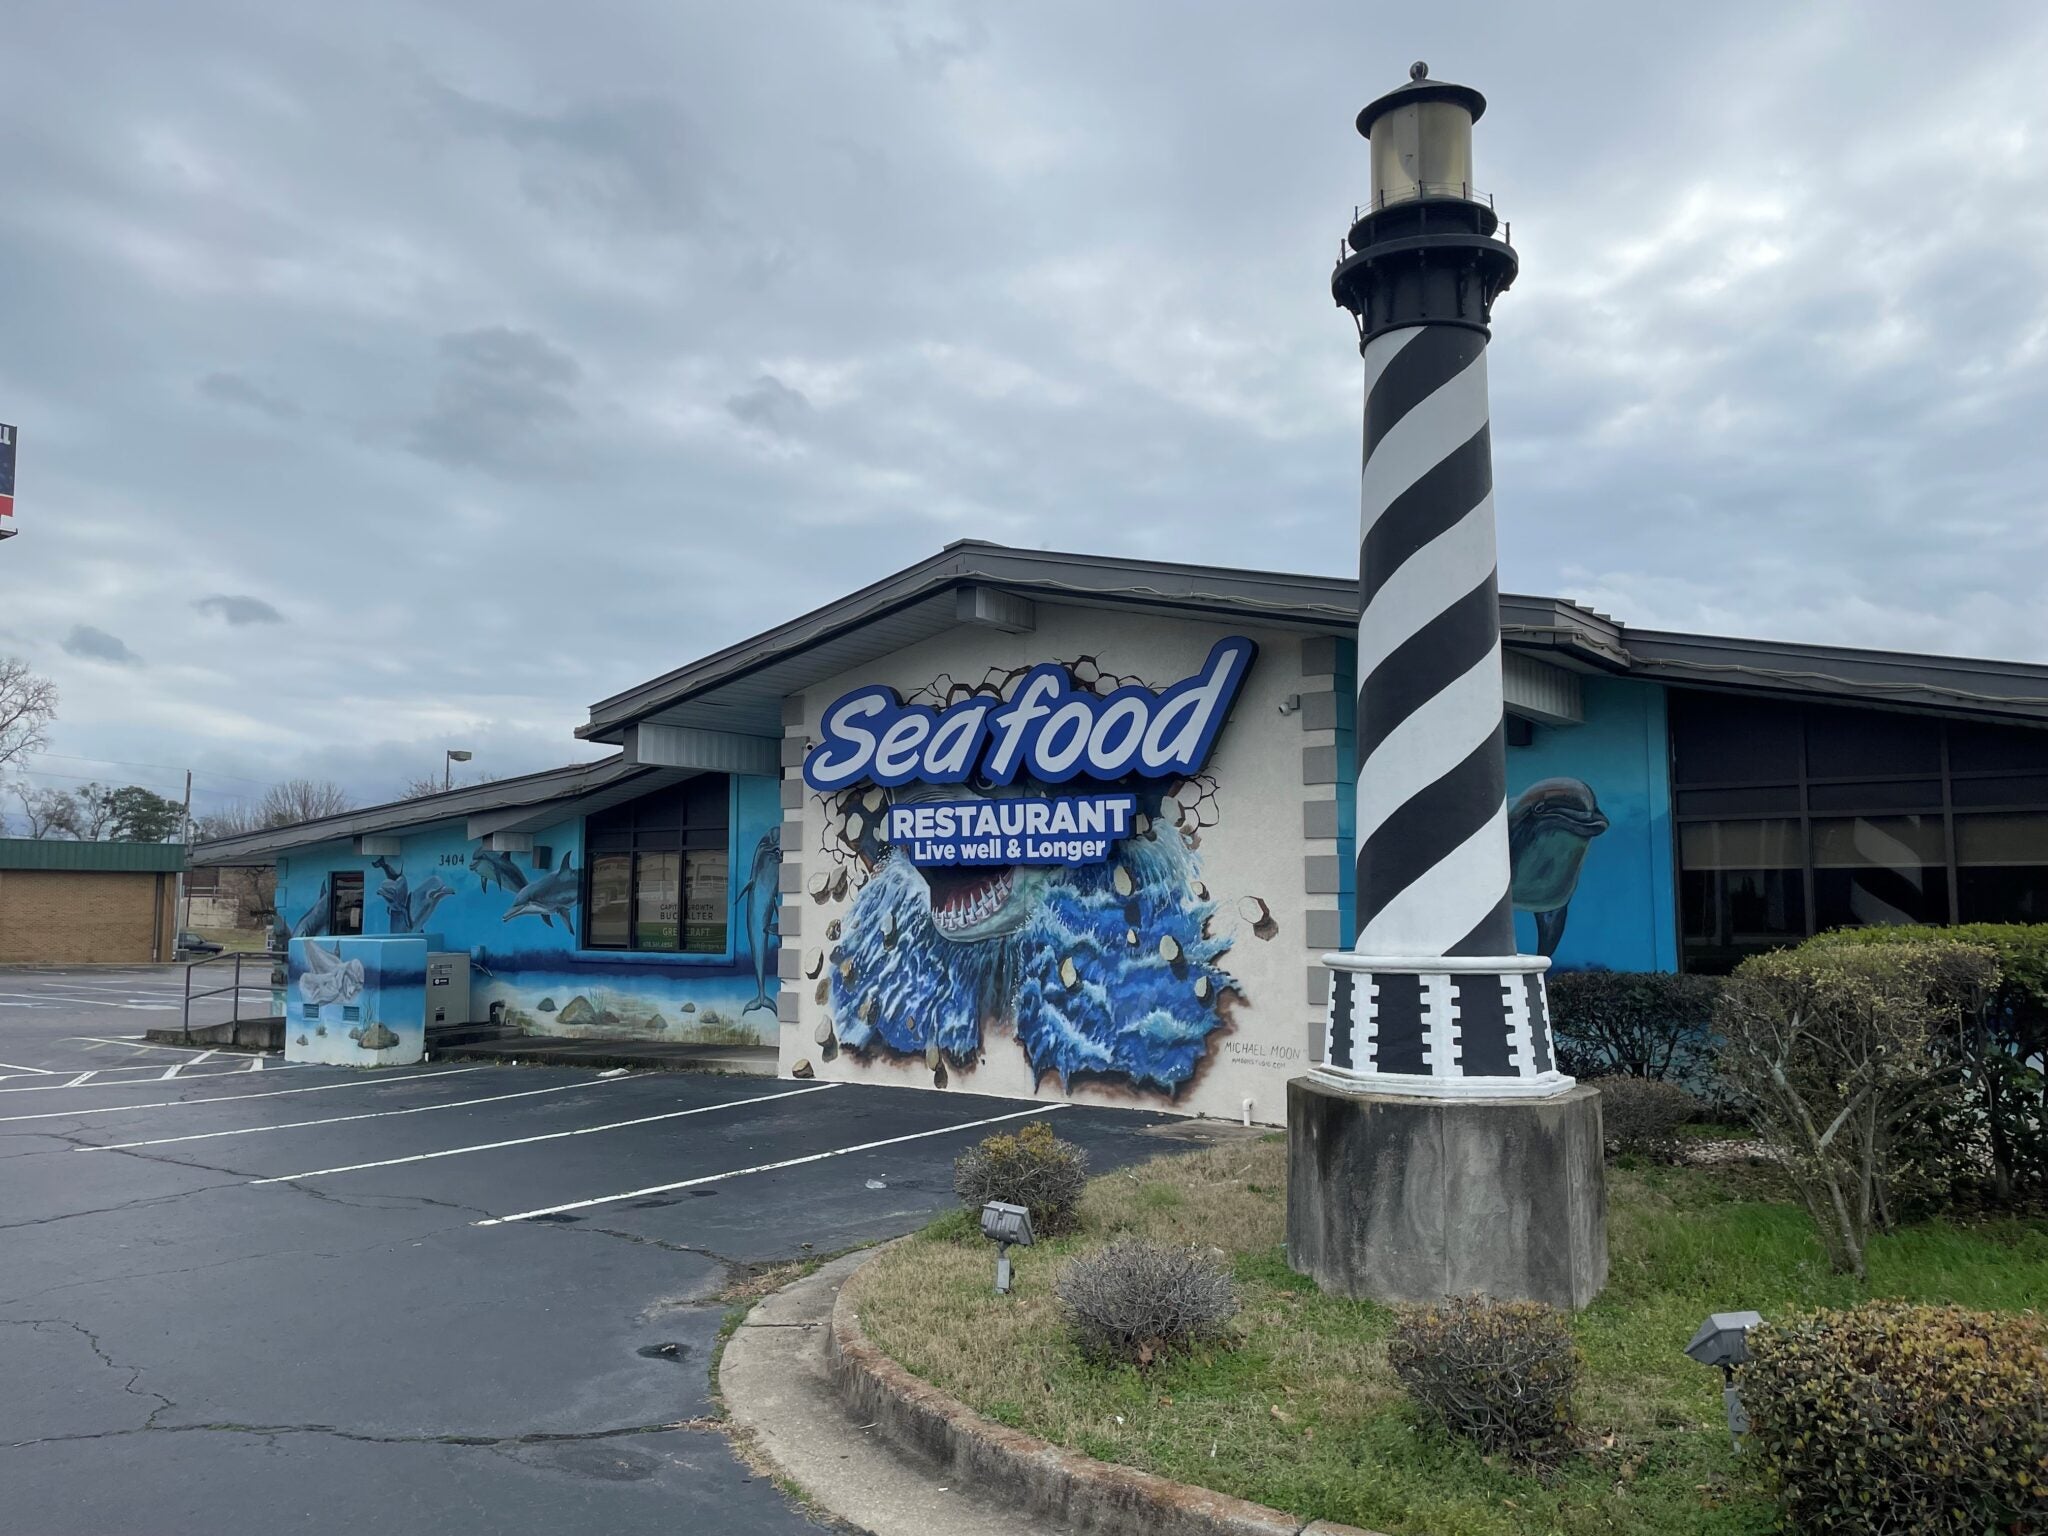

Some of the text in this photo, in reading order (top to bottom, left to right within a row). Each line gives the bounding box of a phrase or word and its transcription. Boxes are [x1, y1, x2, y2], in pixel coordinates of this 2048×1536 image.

[811, 648, 1239, 781] Seafood
[893, 799, 1131, 839] RESTAURANT
[438, 853, 465, 866] 3404
[914, 838, 1106, 861] Live well & Longer
[660, 912, 714, 920] BUCALTER
[1224, 1042, 1300, 1060] MICHAEL MOON
